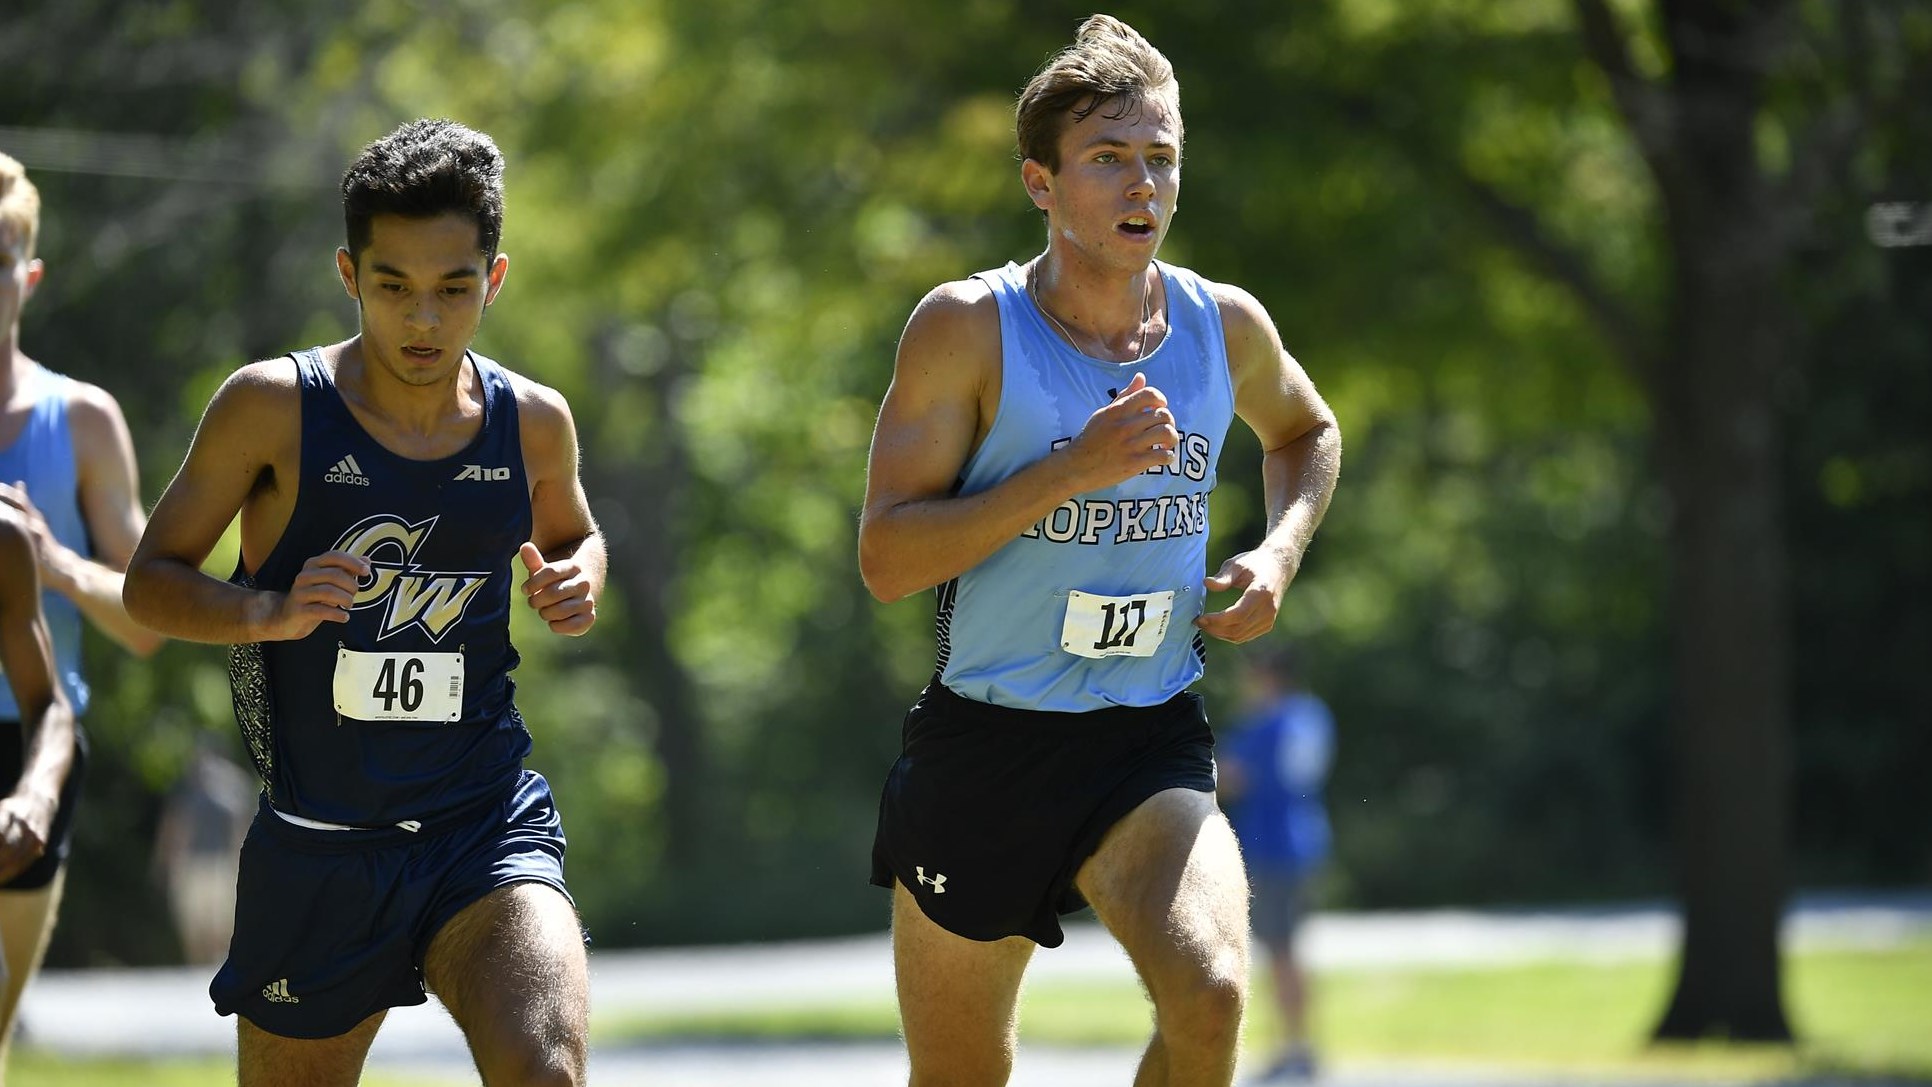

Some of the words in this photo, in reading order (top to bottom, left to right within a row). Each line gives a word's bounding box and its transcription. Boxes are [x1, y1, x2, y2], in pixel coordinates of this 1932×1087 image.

[324, 471, 370, 487] adidas
[453, 464, 511, 482] A10
[1020, 490, 1208, 546] OPKINS
[329, 512, 493, 645] GW
[1093, 599, 1148, 650] 117
[372, 657, 425, 713] 46
[262, 988, 299, 1003] adidas
